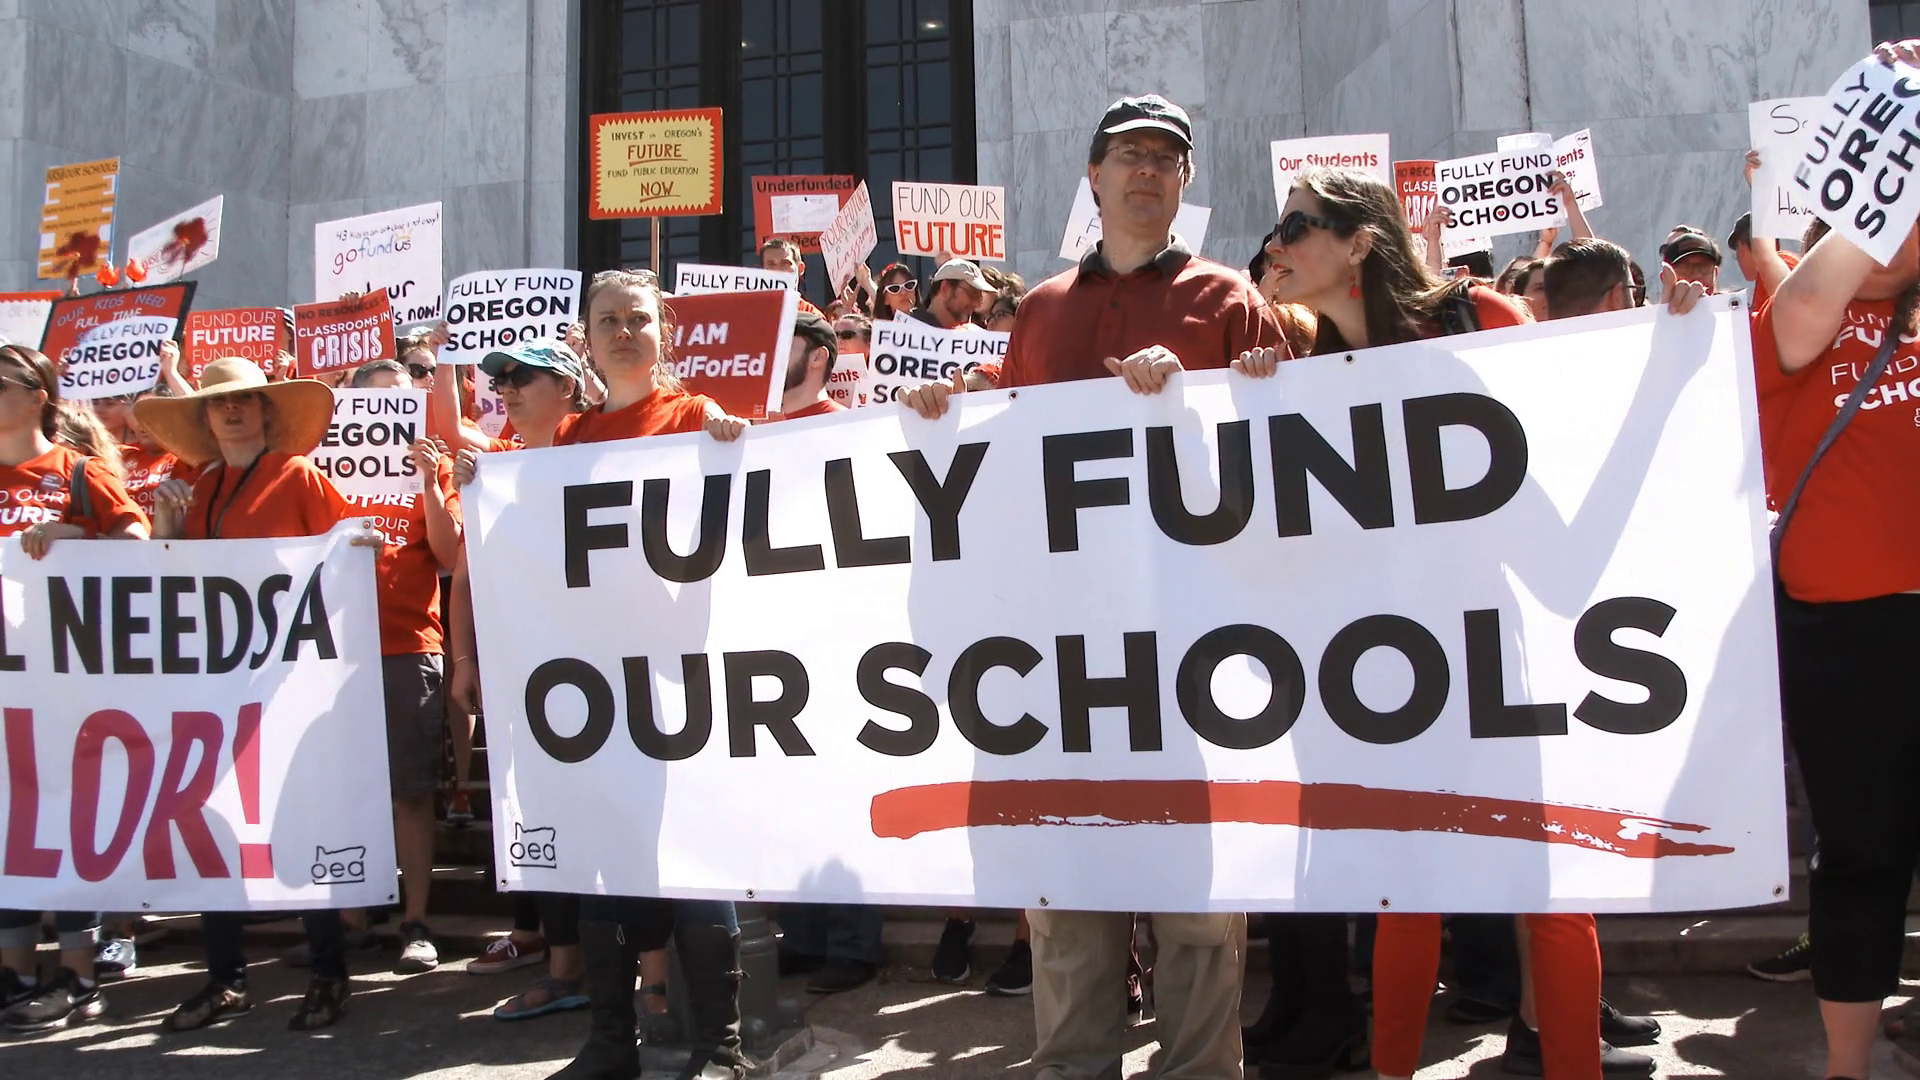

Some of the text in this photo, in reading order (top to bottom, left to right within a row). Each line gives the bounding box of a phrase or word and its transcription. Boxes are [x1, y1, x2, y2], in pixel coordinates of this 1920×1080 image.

[611, 131, 645, 141] INVEST
[1795, 72, 1870, 190] FULLY
[627, 144, 682, 159] FUTURE
[1279, 152, 1378, 171] Our Students
[607, 167, 699, 178] FUND PUBLIC EDUCATION
[1441, 153, 1551, 182] FULLY FUND
[1854, 108, 1920, 239] SCH
[640, 181, 674, 197] NOW
[757, 178, 852, 193] Underfunded
[1441, 173, 1553, 205] OREGON
[898, 187, 1000, 220] FUND OUR
[1445, 198, 1558, 229] SCHOOLS
[336, 230, 348, 241] 43
[898, 220, 1003, 258] FUTURE
[451, 276, 574, 300] FULLY FUND
[681, 272, 788, 290] FULLY FUND
[57, 307, 84, 326] OUR
[95, 296, 124, 309] KIDS
[135, 294, 166, 307] NEED
[192, 311, 276, 328] FUND OUR
[298, 310, 315, 319] NO
[318, 299, 379, 317] RESOURCES
[408, 295, 440, 320] now!
[447, 296, 570, 325] OREGON
[75, 316, 100, 329] FULL
[121, 323, 168, 337] FUND
[298, 315, 378, 337] CLASSROOMS
[380, 310, 390, 322] IN
[674, 322, 729, 347] I AM
[192, 325, 276, 346] FUTURE
[878, 330, 1009, 356] FULLY FUND
[68, 340, 162, 365] OREGON
[192, 344, 274, 362] FUND OUR
[312, 326, 383, 370] CRISIS
[62, 363, 159, 387] SCHOOLS
[1831, 356, 1918, 385] FUD
[352, 398, 418, 415] FUND
[321, 422, 416, 447] EGON
[314, 455, 418, 479] HOOLS
[16, 488, 65, 504] OUR
[345, 493, 416, 509] UTURE
[564, 392, 1528, 588] FULLY FUND
[0, 506, 62, 525] URE
[373, 515, 410, 533] OUR
[525, 596, 1688, 763] OUR SCHOOLS
[3, 702, 274, 882] LOR!
